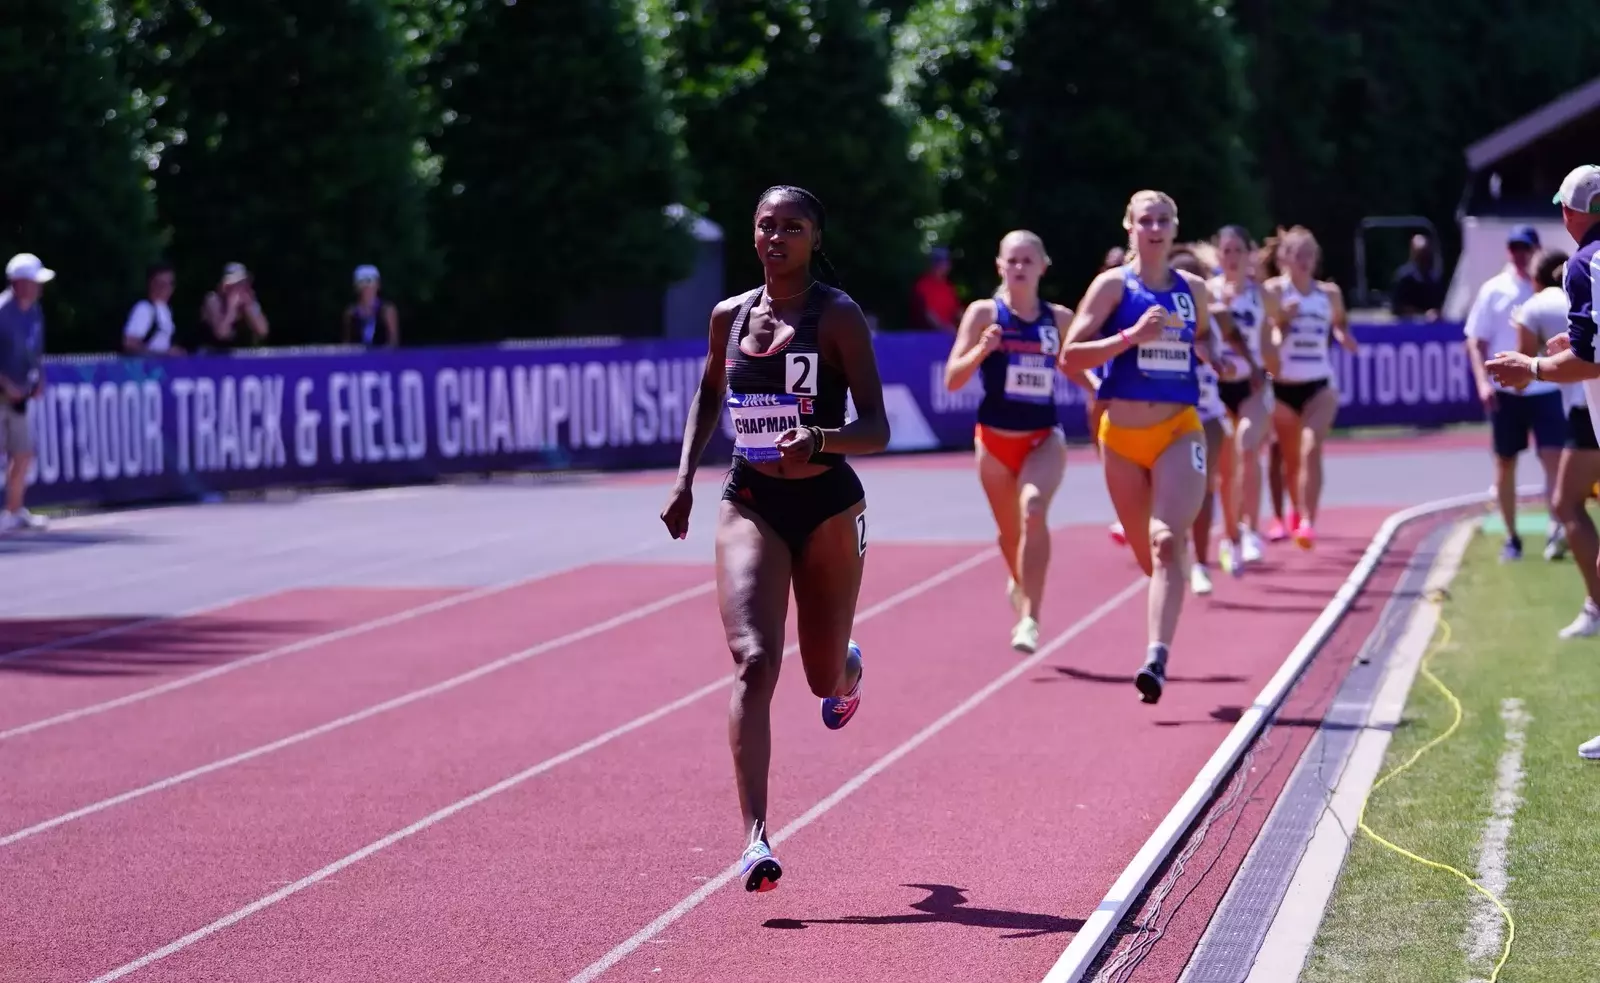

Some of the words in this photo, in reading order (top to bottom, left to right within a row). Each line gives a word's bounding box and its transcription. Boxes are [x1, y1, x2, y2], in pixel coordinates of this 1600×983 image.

[1178, 295, 1191, 318] 9
[1044, 329, 1055, 351] 5
[791, 355, 812, 394] 2
[1332, 341, 1470, 406] UTDOOR
[172, 374, 287, 474] TRACK
[295, 376, 321, 467] &
[328, 367, 428, 464] FIELD
[436, 356, 736, 459] CHAMPIONSHI
[734, 415, 797, 434] CHAPMAN
[857, 513, 867, 551] 2
